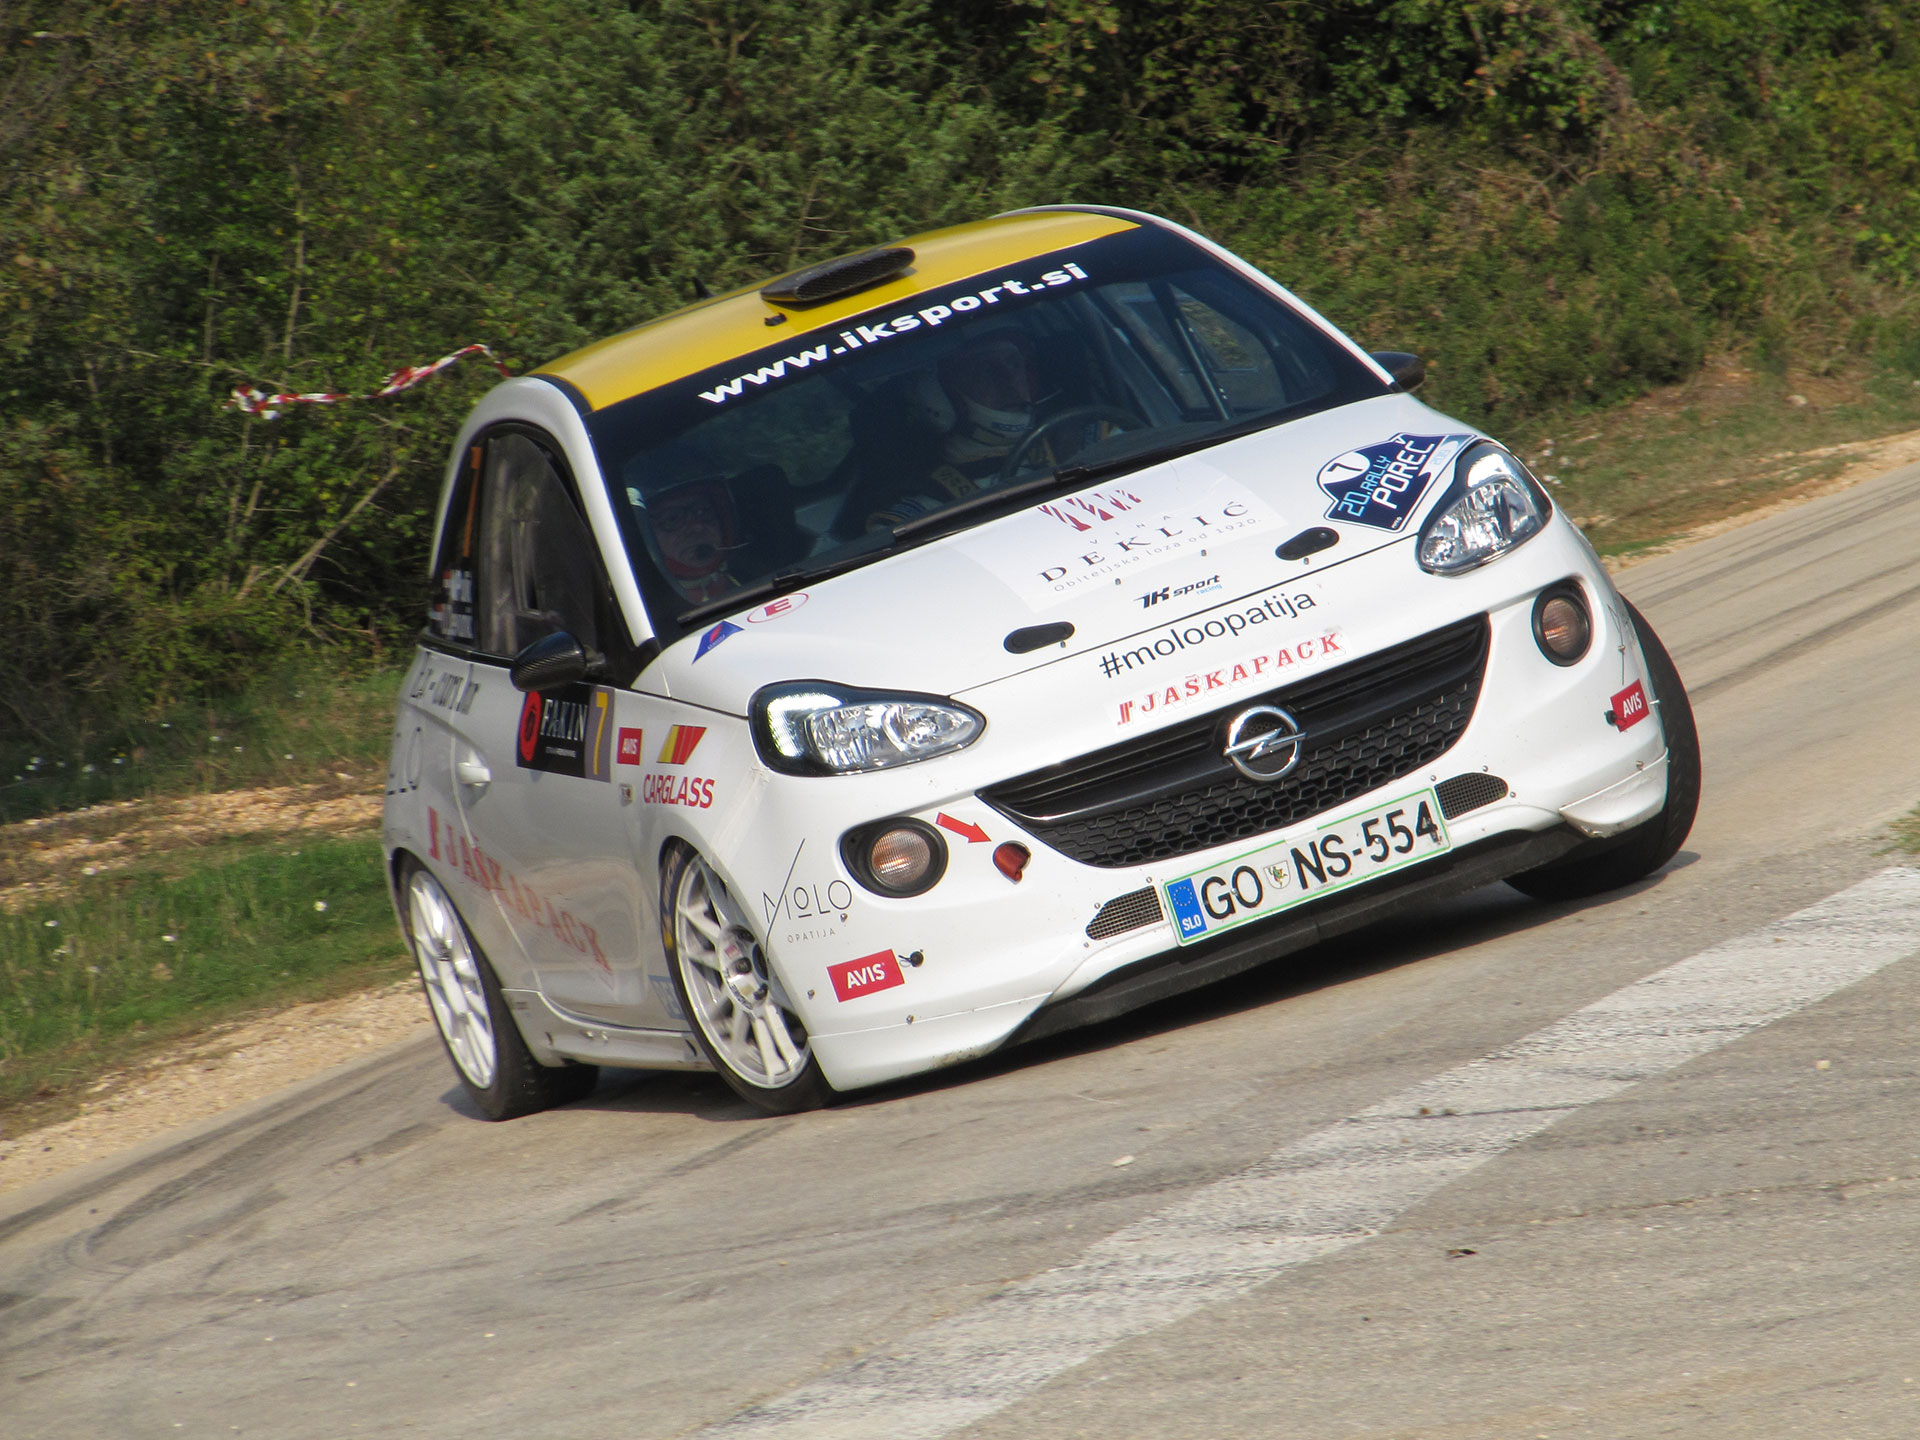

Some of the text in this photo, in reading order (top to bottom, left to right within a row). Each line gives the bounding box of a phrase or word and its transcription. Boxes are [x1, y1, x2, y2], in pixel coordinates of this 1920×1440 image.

[698, 262, 1089, 404] www.iksport.si
[1037, 501, 1249, 582] DEKLIĆ
[1054, 517, 1262, 592] Obiteljska loza od 1920.
[1173, 574, 1221, 598] sport
[1196, 583, 1223, 595] racing
[1099, 591, 1317, 679] #moloopatija
[1141, 633, 1341, 713] JAŠKAPACK
[1622, 691, 1643, 719] AVIS
[643, 773, 716, 809] CARGLASS
[1201, 800, 1440, 920] GO NS-554
[787, 927, 836, 944] OPATIJA
[1182, 914, 1202, 932] SLO
[847, 963, 886, 989] AVIS
